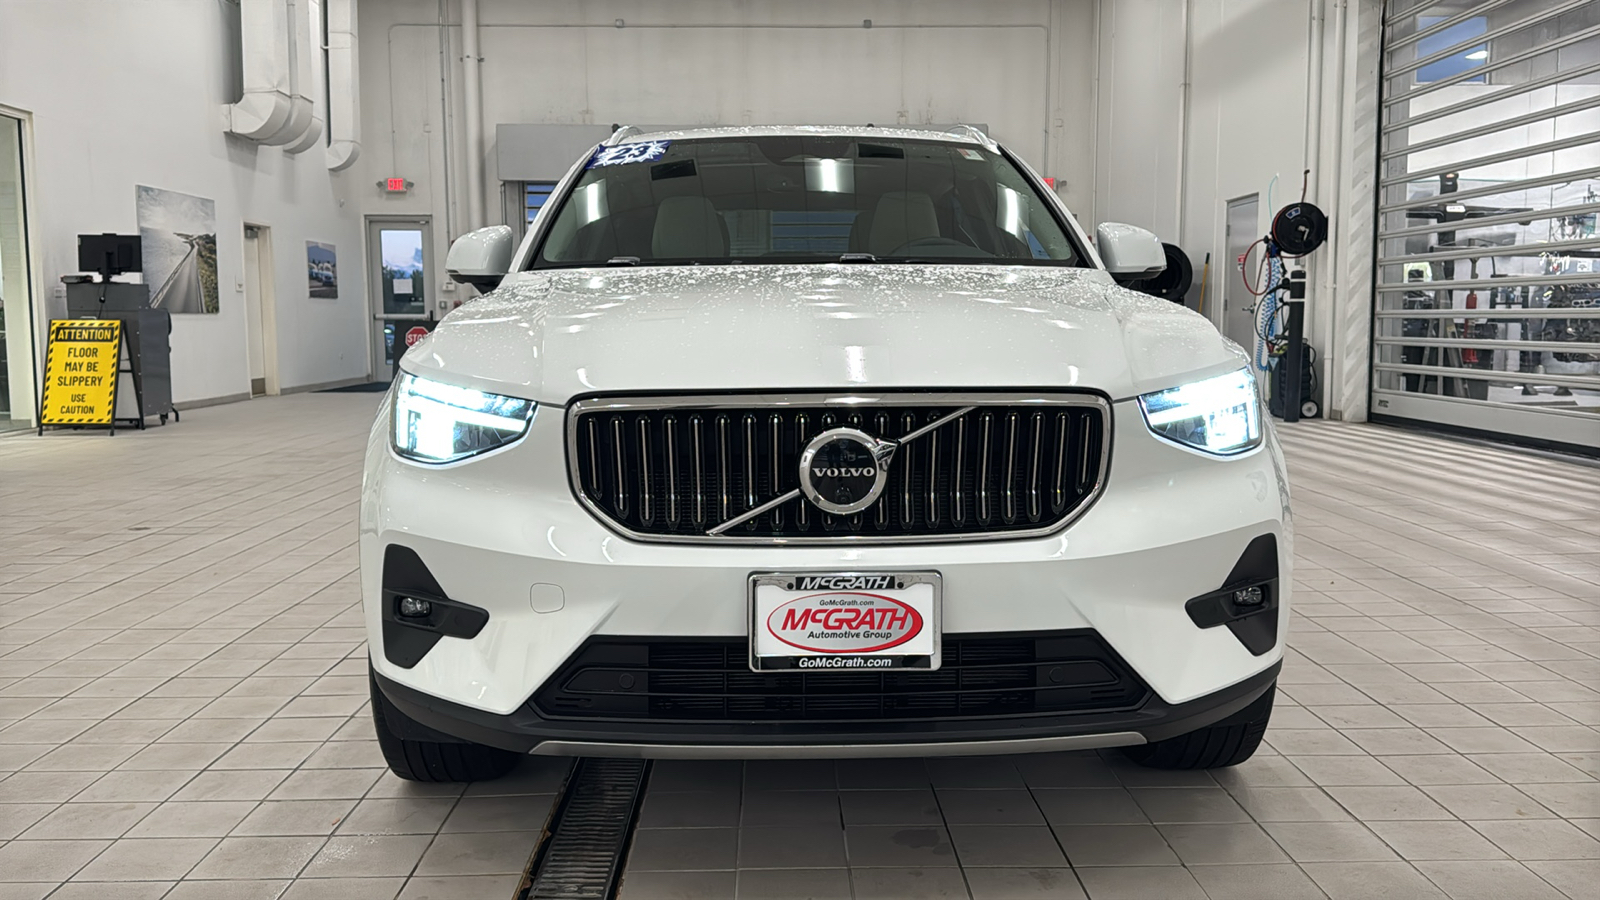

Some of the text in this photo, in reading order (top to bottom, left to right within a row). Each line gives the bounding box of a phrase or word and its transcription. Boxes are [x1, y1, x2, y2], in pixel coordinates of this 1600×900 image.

[387, 178, 404, 190] EXIT
[57, 328, 112, 340] ATTENTION
[407, 333, 428, 343] STO
[67, 347, 98, 358] FLOOR
[64, 361, 99, 372] MAY BE
[57, 376, 103, 386] SLIPPERY
[71, 394, 86, 403] USE
[60, 405, 95, 415] CAUTION
[812, 467, 875, 477] VOLVO
[819, 599, 875, 607] GoMcGrath.com
[807, 630, 892, 641] Automotive Group
[799, 656, 892, 669] GoMcGrath.com
